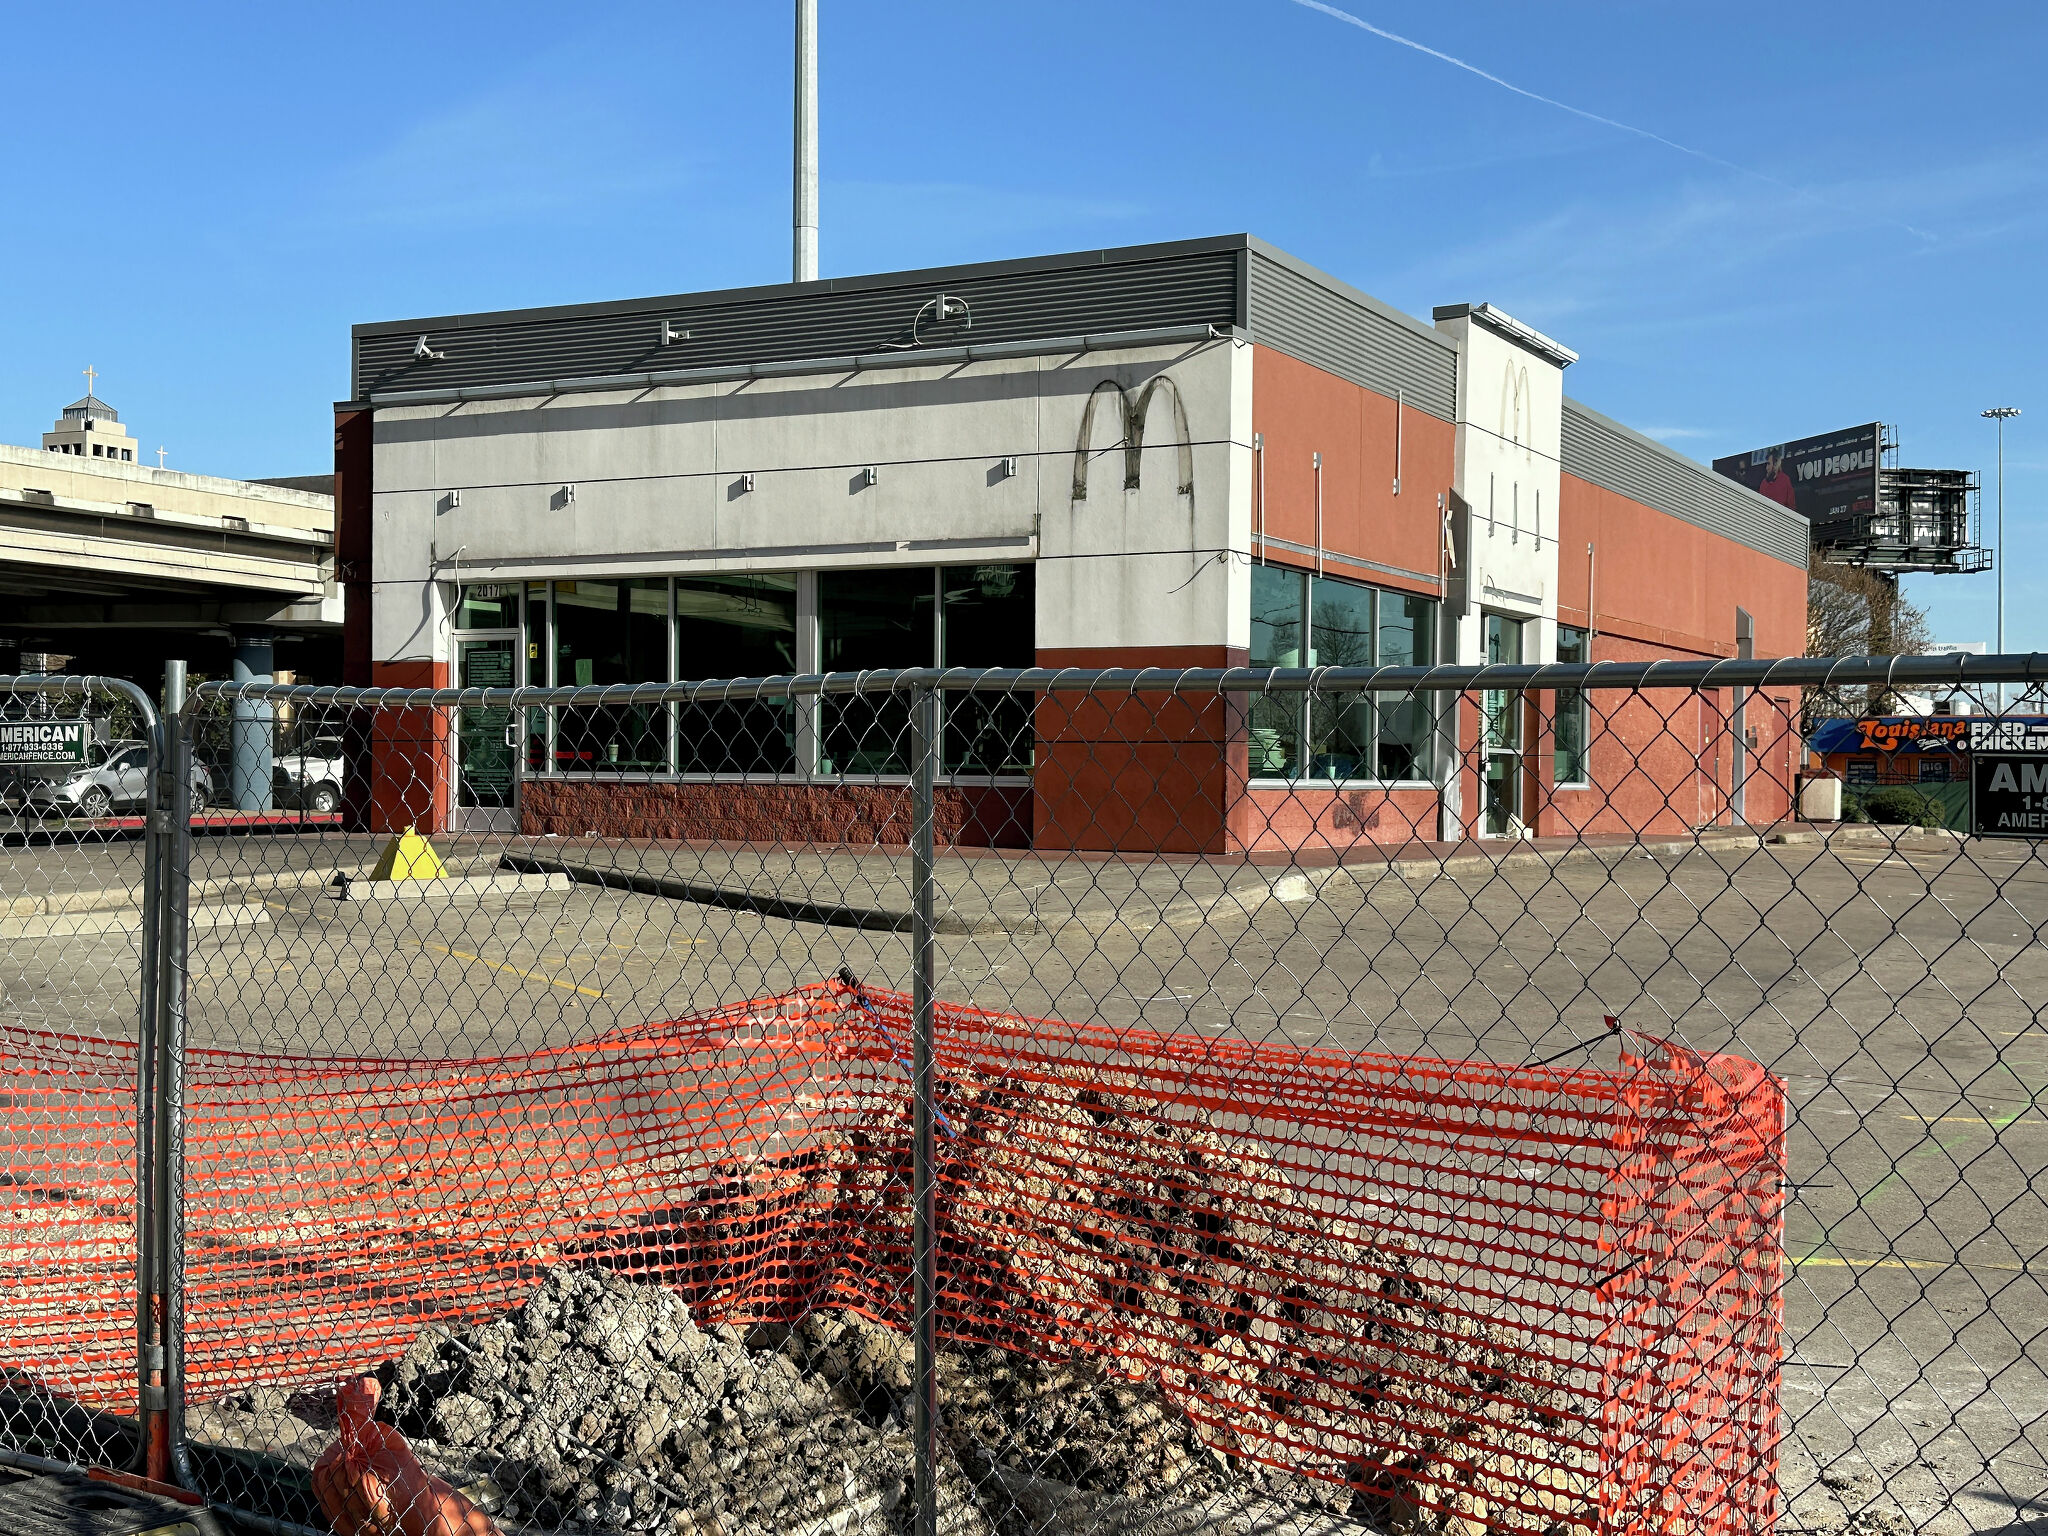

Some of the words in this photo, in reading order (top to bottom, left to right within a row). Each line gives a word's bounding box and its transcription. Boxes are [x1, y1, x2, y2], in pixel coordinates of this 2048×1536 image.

[1796, 459, 1822, 482] YOU
[1824, 448, 1874, 477] PEOPLE
[477, 584, 500, 597] 2017
[0, 726, 79, 742] MERICAN
